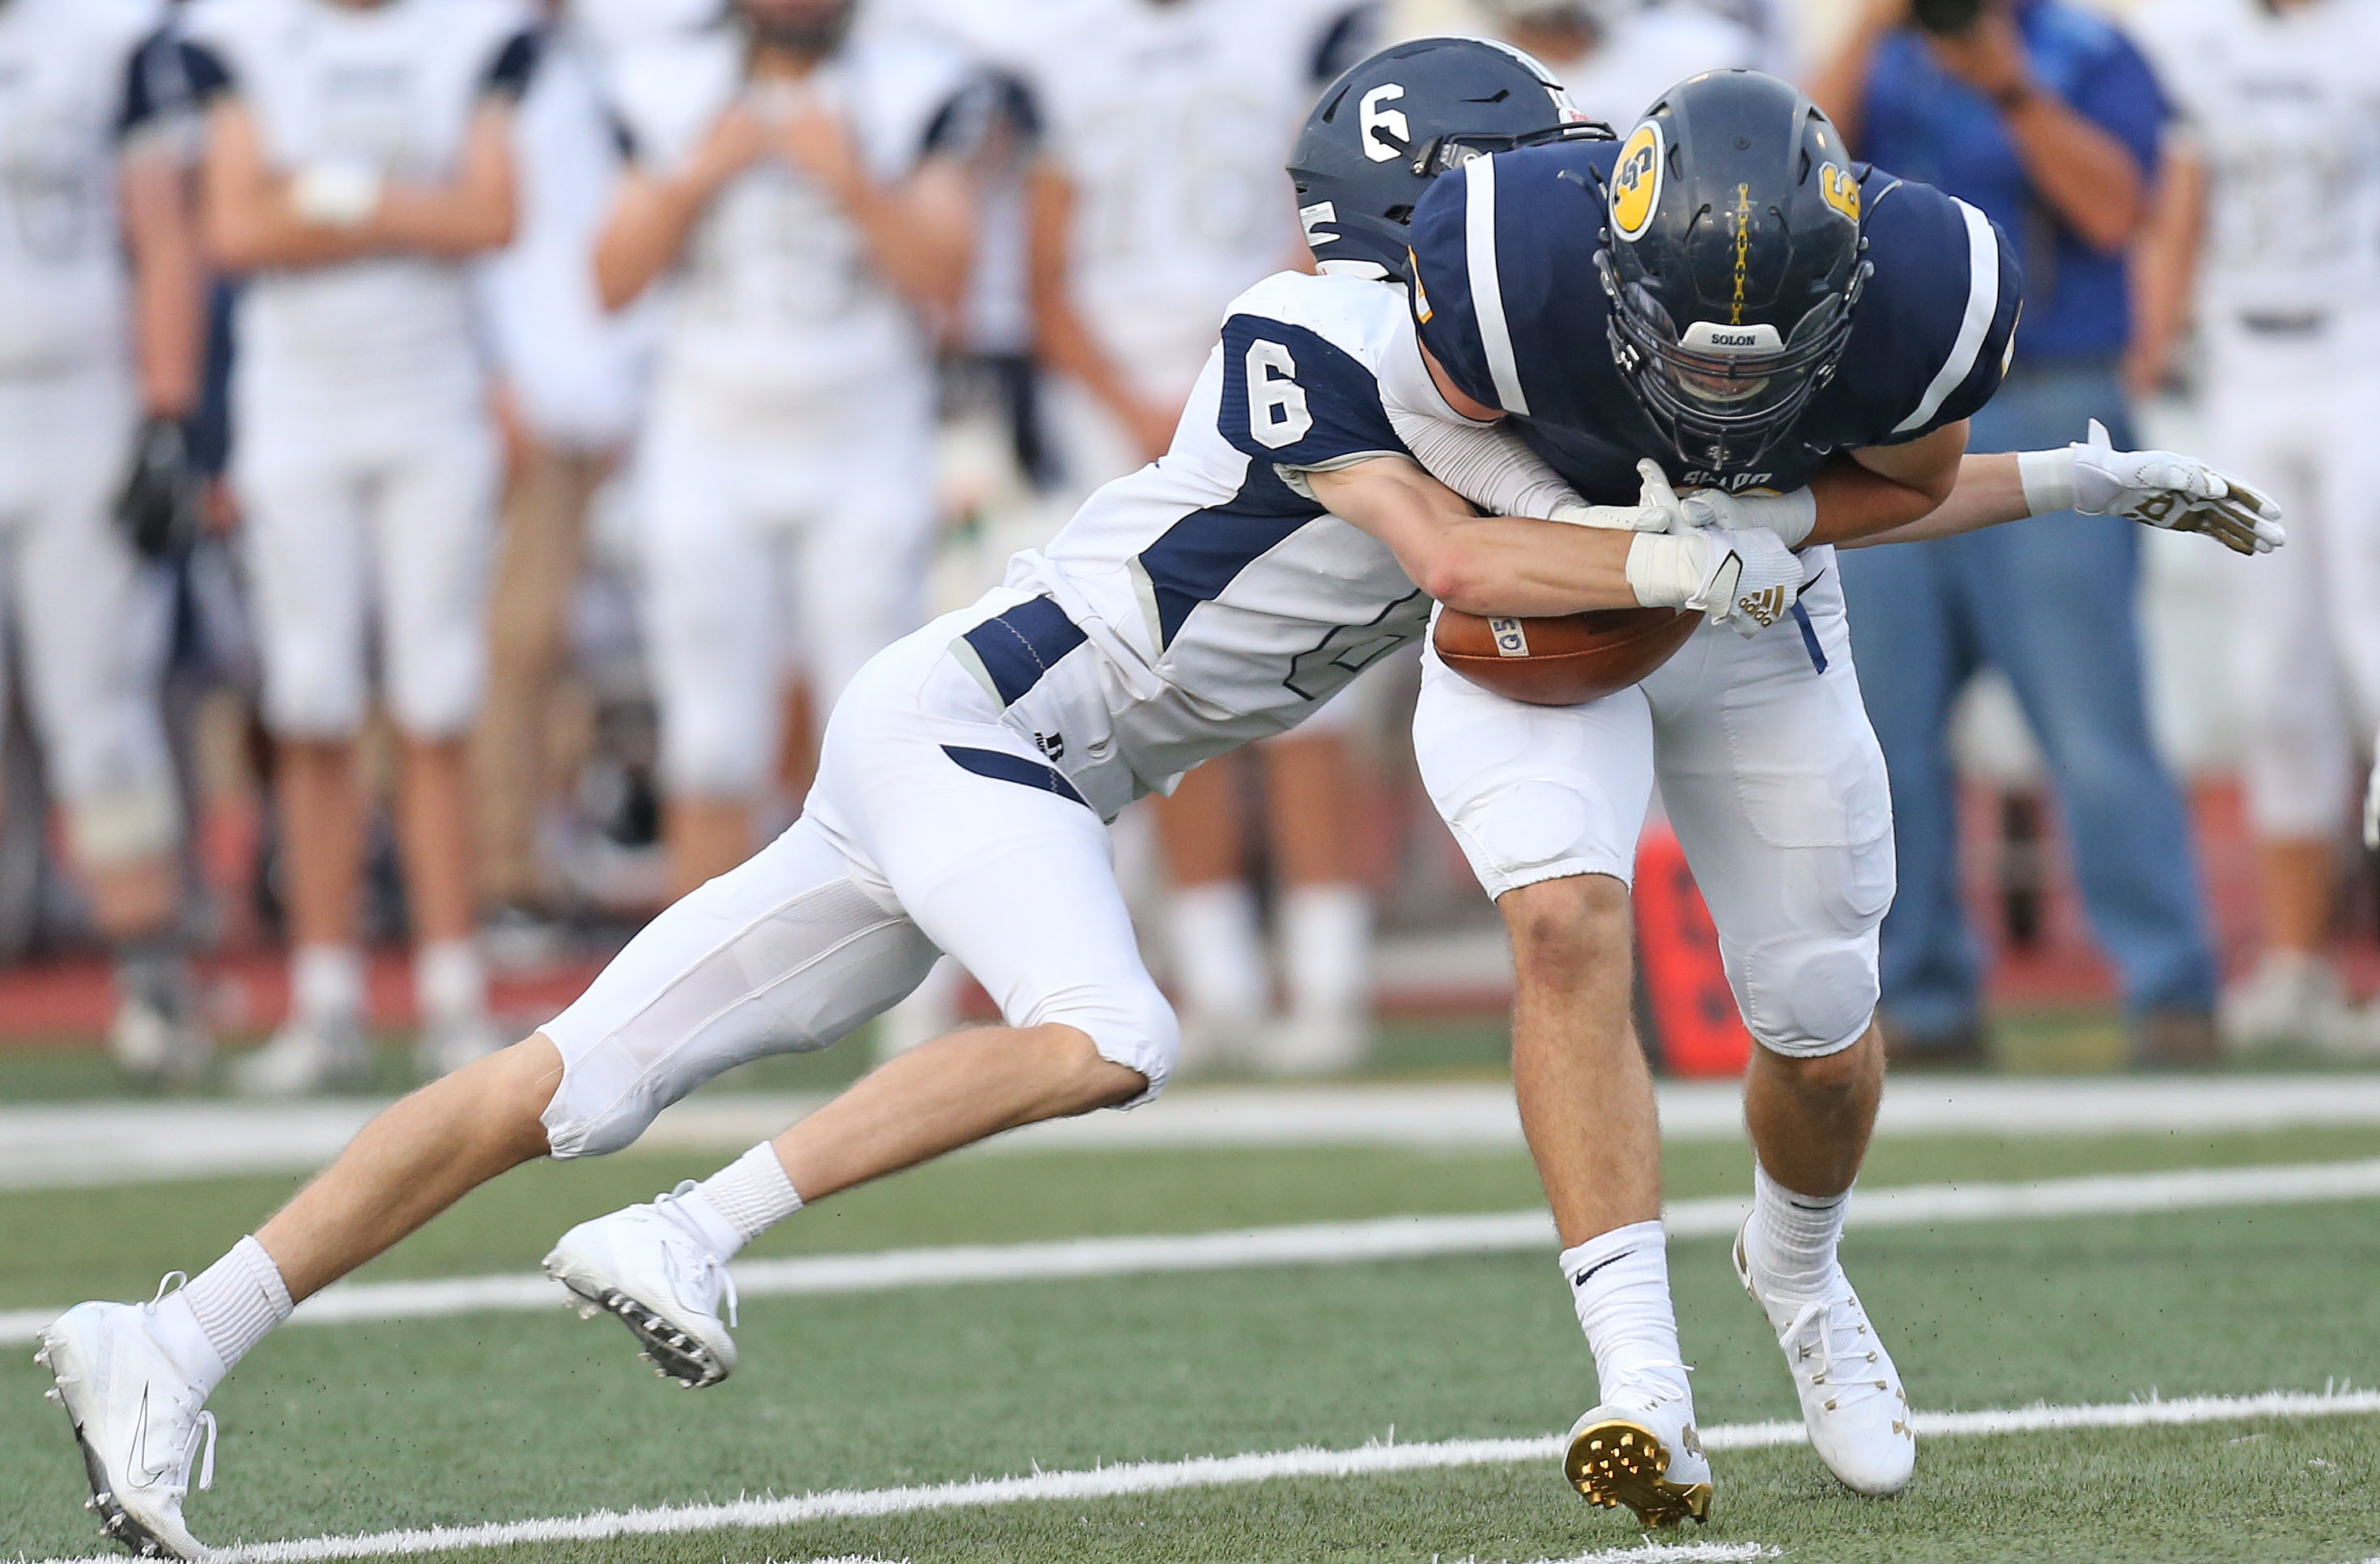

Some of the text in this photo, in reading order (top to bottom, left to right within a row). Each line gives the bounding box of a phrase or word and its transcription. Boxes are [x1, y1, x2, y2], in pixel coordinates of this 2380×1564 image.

[1358, 82, 1410, 163] 6
[1818, 160, 1861, 226] 6
[1711, 334, 1756, 346] SOLON
[1245, 337, 1315, 450] 6
[1738, 596, 1773, 627] adida
